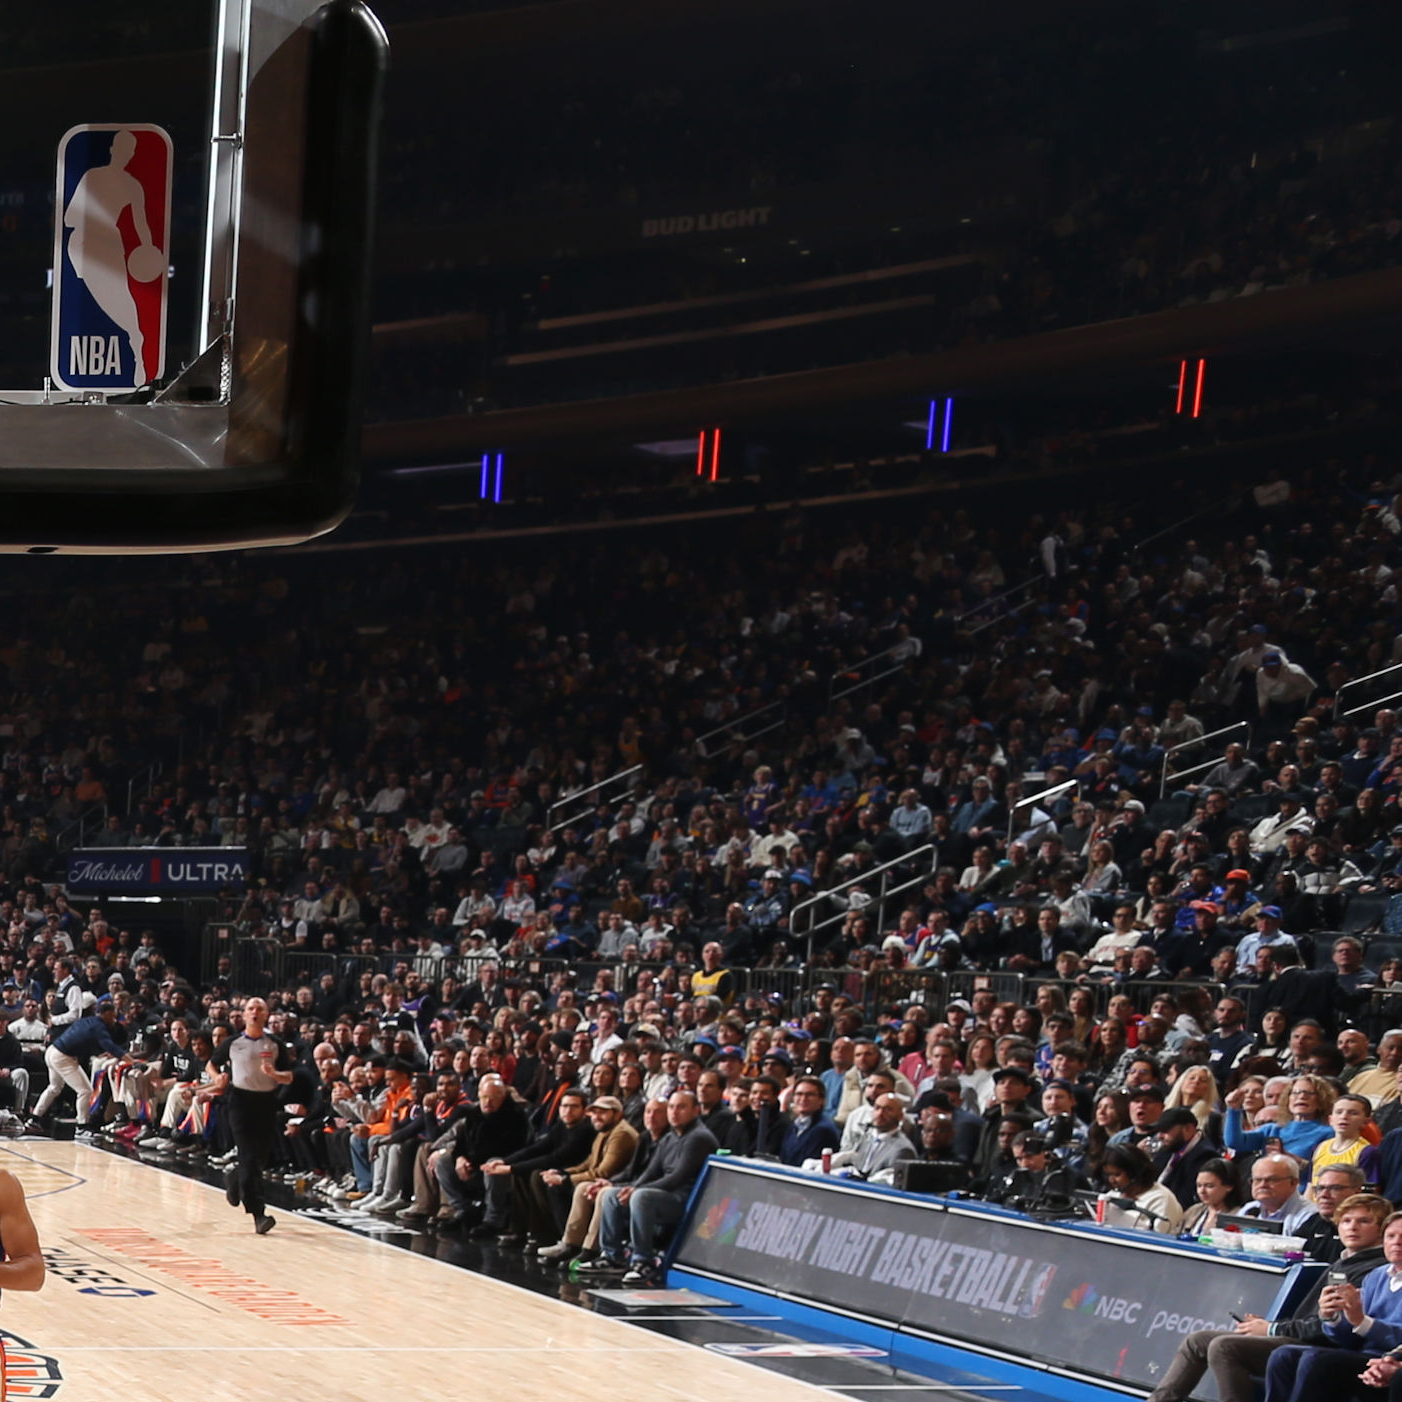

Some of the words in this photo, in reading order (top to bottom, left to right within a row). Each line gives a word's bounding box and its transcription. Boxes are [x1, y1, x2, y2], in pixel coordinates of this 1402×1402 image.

[642, 215, 694, 238] BUD
[697, 205, 773, 232] LIGHT
[69, 335, 122, 377] NBA
[168, 863, 244, 882] ULTRA
[734, 1201, 820, 1263] SUNDAY
[808, 1215, 882, 1278] NIGHT
[871, 1231, 1035, 1316] BASKETBALL
[1094, 1295, 1142, 1325] NBC
